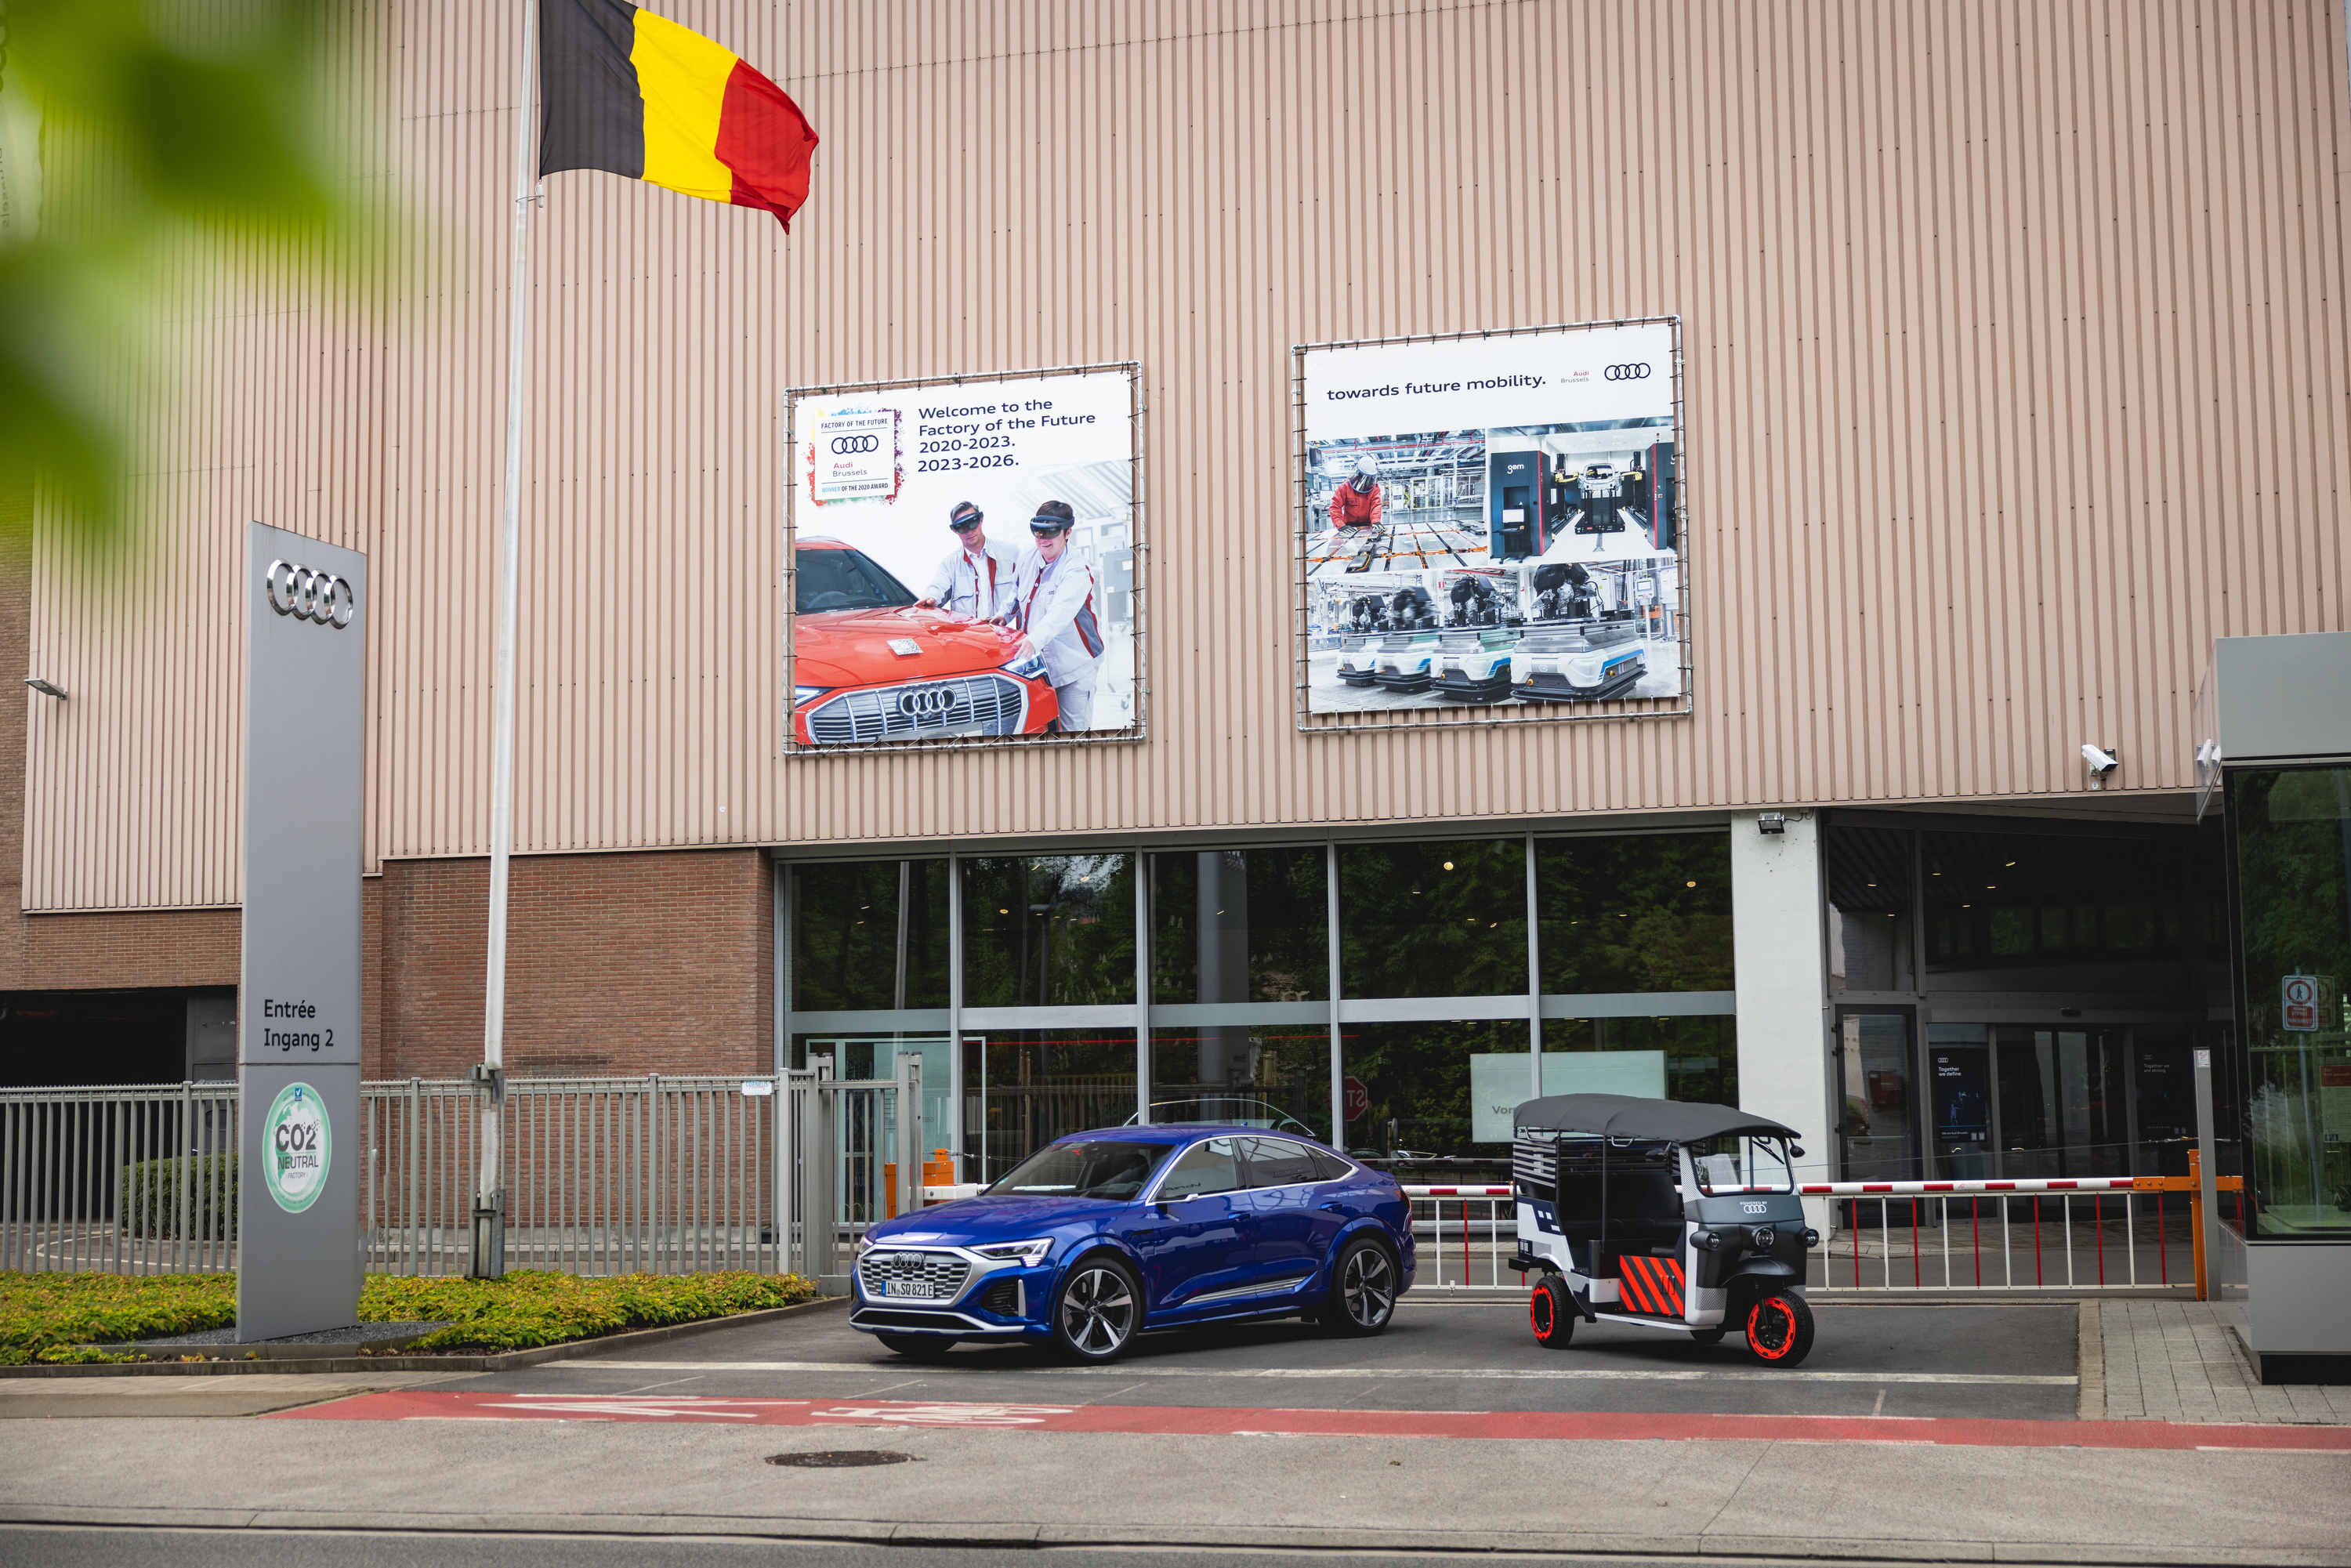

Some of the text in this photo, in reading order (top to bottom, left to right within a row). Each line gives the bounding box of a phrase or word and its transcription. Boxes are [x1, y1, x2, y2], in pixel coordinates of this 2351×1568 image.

[1327, 374, 1546, 400] towards future mobility.
[918, 399, 1052, 419] Welcome to the
[919, 414, 1096, 436] Factory of the Future
[919, 435, 1016, 453] 2020-2023.
[918, 454, 1020, 472] 2023-2026.
[1507, 464, 1524, 475] gom
[832, 469, 868, 477] Brussels
[264, 999, 316, 1019] Entrée
[264, 1028, 334, 1052] Ingang 2
[275, 1123, 317, 1153] CO2
[277, 1155, 319, 1170] NEUTRAL
[887, 1283, 897, 1295] IN
